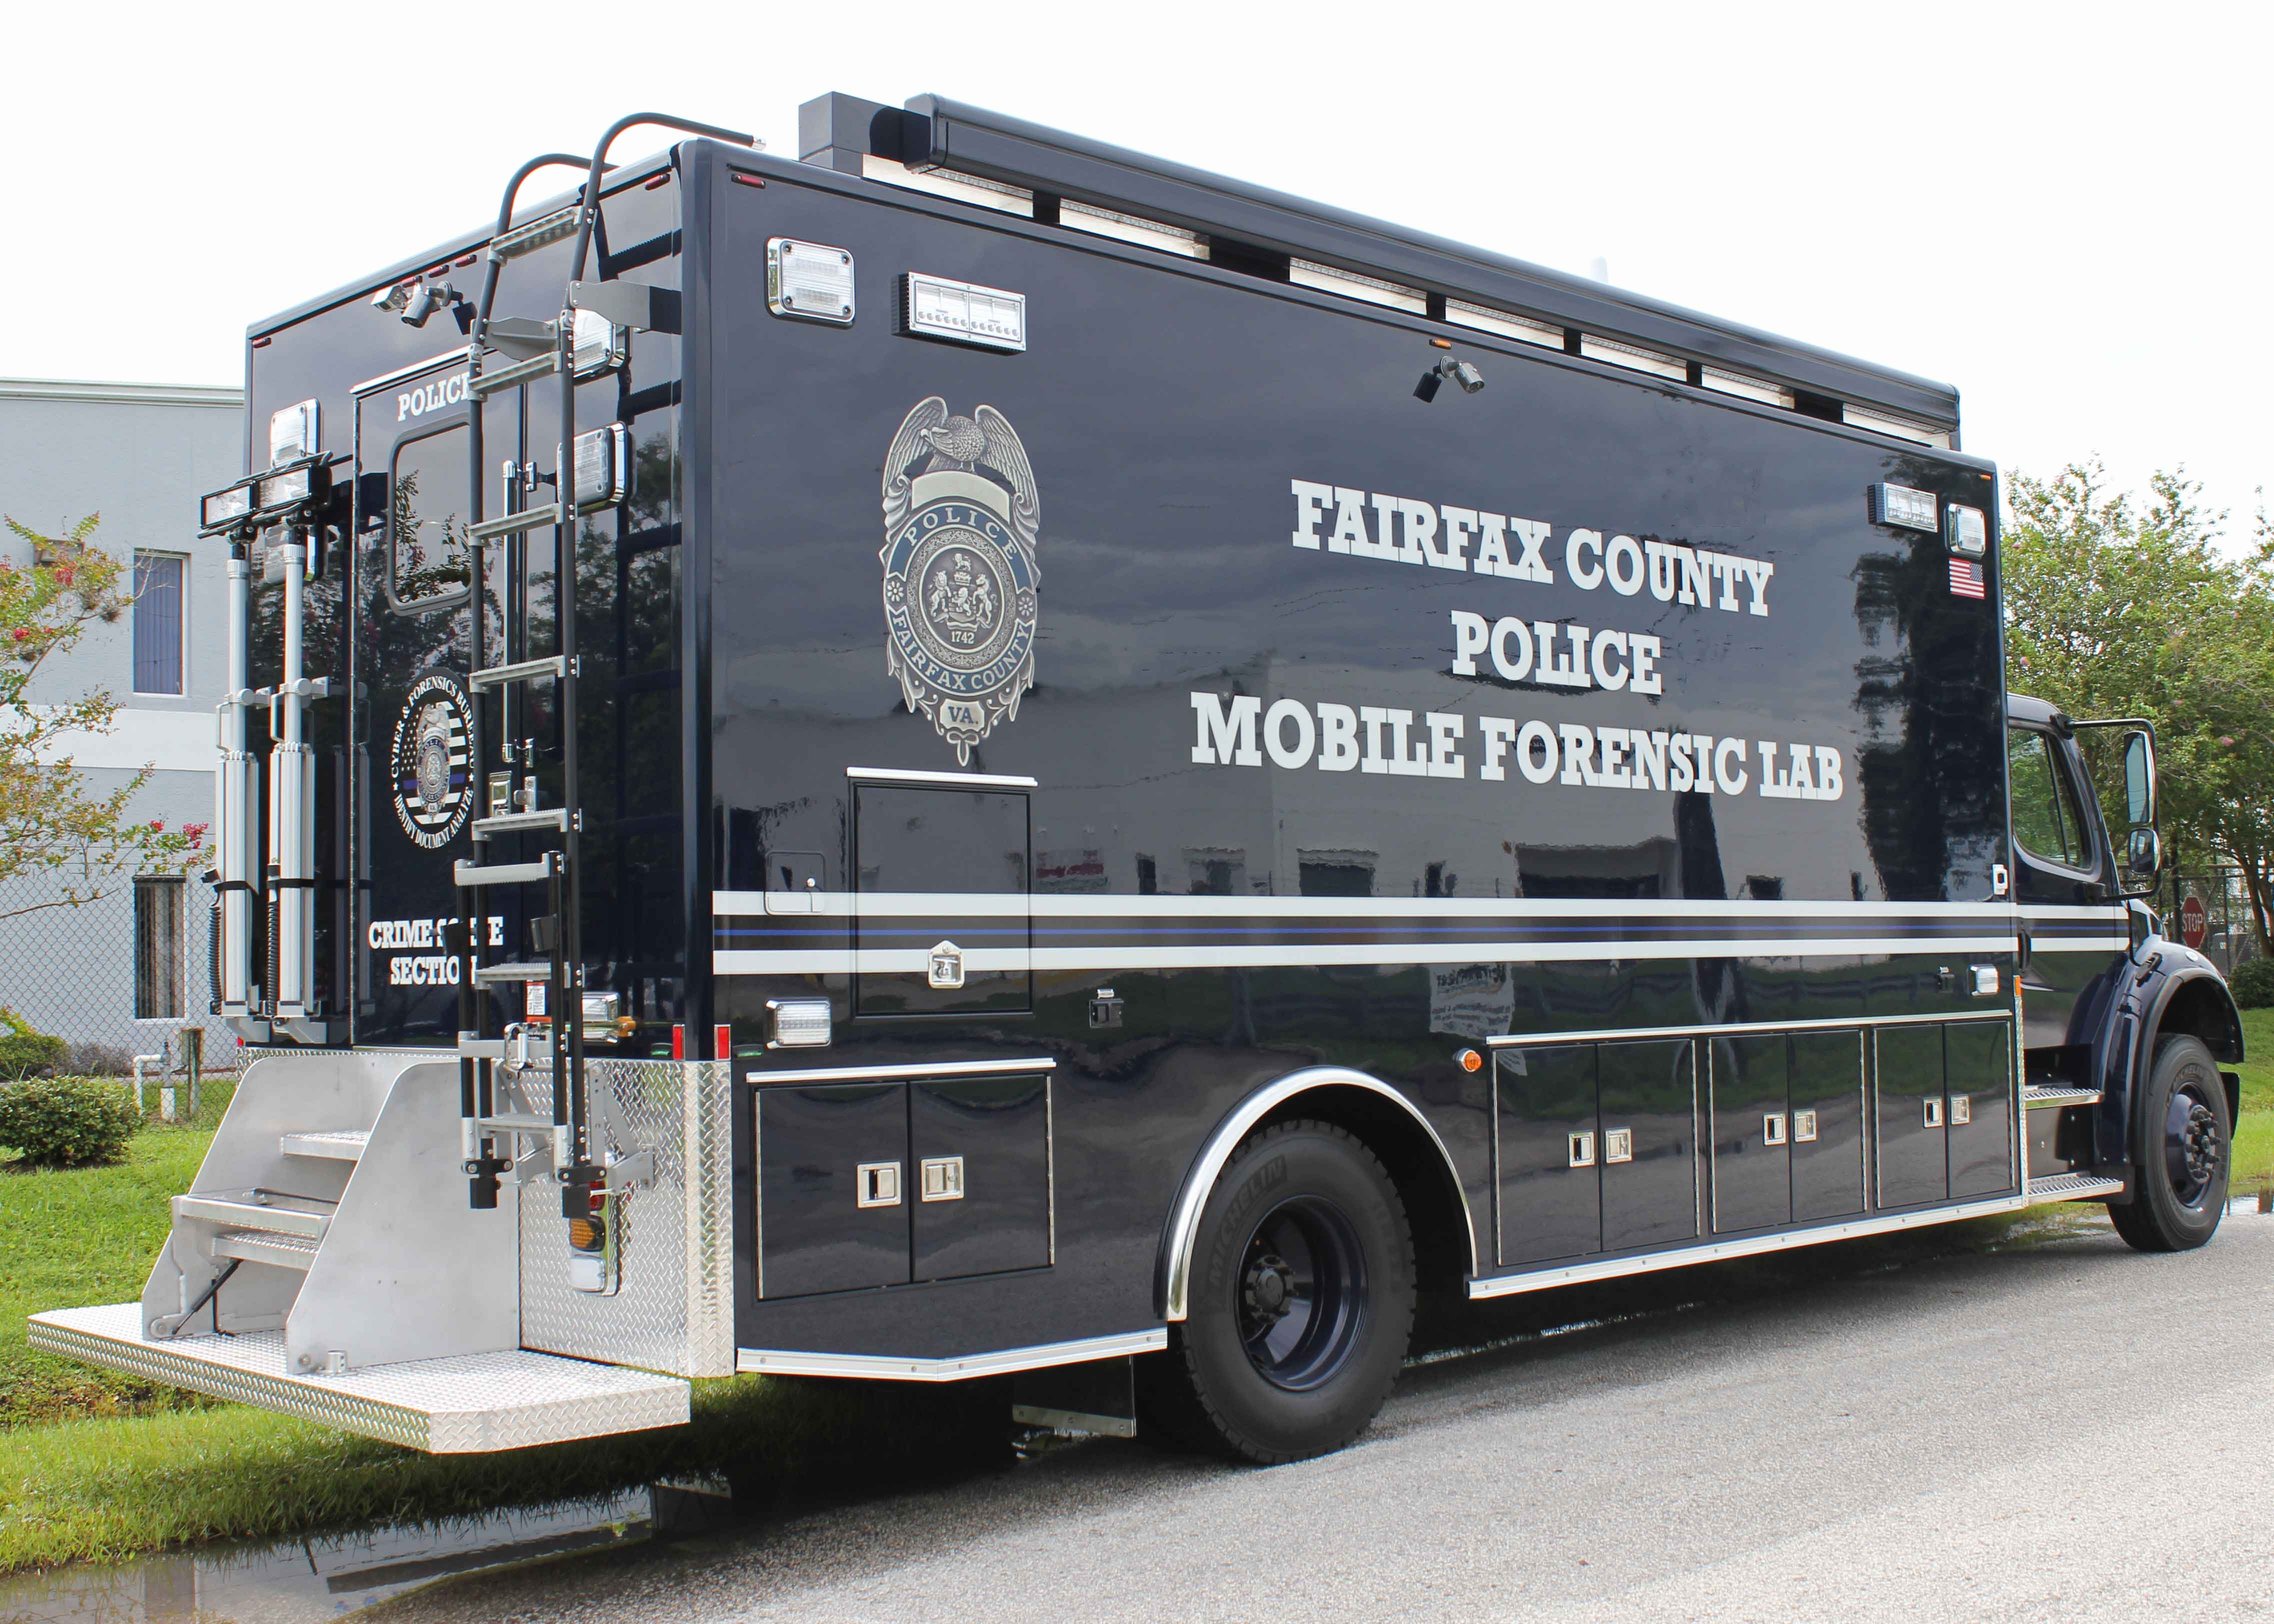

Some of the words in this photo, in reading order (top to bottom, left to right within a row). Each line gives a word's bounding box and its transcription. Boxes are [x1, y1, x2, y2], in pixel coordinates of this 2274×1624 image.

[904, 506, 1017, 560] POLICE
[1291, 478, 1554, 585] FAIRFAX
[1565, 528, 1774, 617] COUNTY
[892, 616, 967, 690] FAIRFAX
[970, 624, 1030, 690] COUNTY
[951, 631, 975, 645] 1742
[1451, 610, 1662, 696] POLICE
[391, 720, 406, 778] CYBER
[407, 675, 458, 708] FORENSICS
[948, 706, 979, 725] VA.
[1190, 691, 1465, 779] MOBILE
[1479, 716, 1748, 796] FORENSIC
[1758, 740, 1843, 801] LAB
[393, 793, 418, 840] IDENTIFY
[414, 826, 450, 849] DOCUMENT
[449, 786, 474, 838] ANALYZE
[368, 919, 434, 950] CRIME
[2182, 913, 2203, 932] STOP
